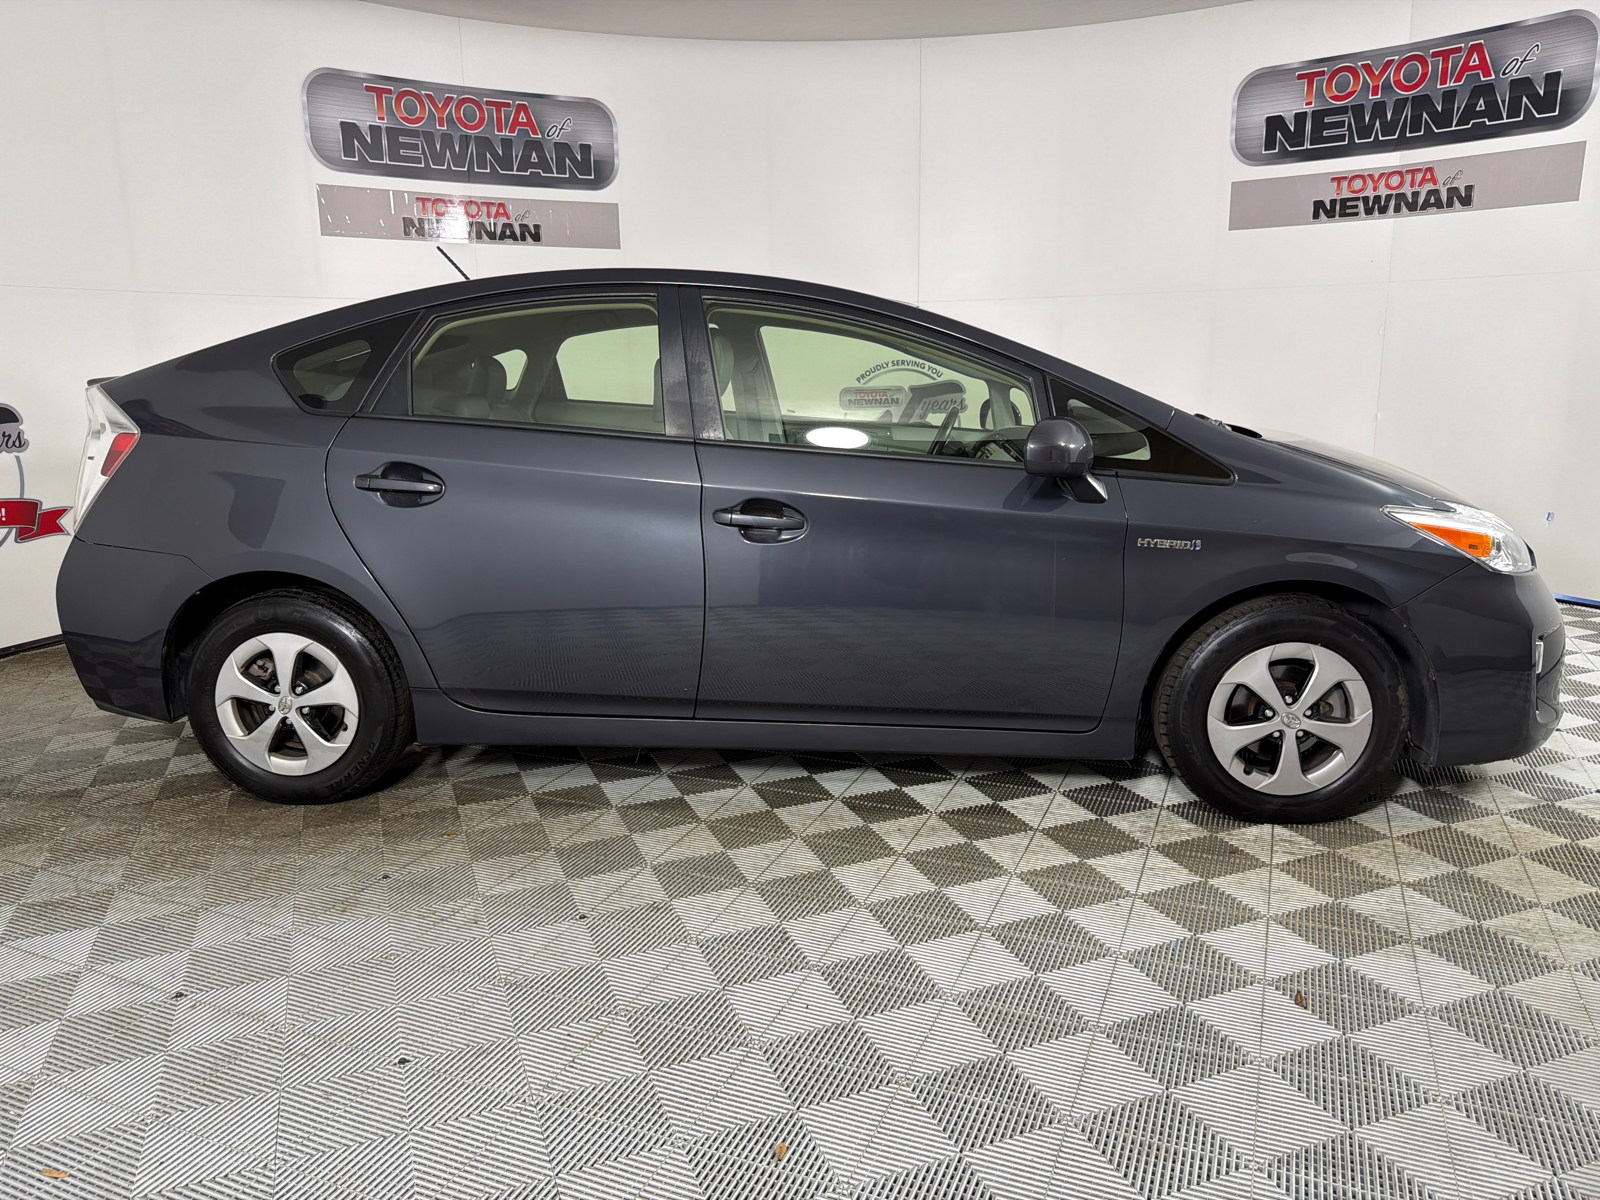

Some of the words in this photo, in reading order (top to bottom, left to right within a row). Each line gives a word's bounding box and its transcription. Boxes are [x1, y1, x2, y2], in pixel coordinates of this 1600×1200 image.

[1296, 40, 1495, 107] TOYOTA
[1500, 43, 1541, 78] of
[364, 84, 540, 138] TOYOTA
[545, 117, 572, 139] of
[1262, 69, 1563, 153] NEWNAN
[339, 120, 594, 178] NEWNAN
[1331, 166, 1439, 196] TOYOTA
[1443, 169, 1463, 186] of
[514, 210, 531, 222] of
[1311, 184, 1475, 221] NEWNAN
[402, 216, 542, 243] NNAN
[856, 361, 889, 384] PROUDLY
[891, 360, 926, 370] SERVING
[927, 365, 944, 378] YOU
[848, 398, 899, 406] NEWNAN
[853, 391, 888, 399] TOYOTA
[1137, 538, 1191, 549] HYBRID
